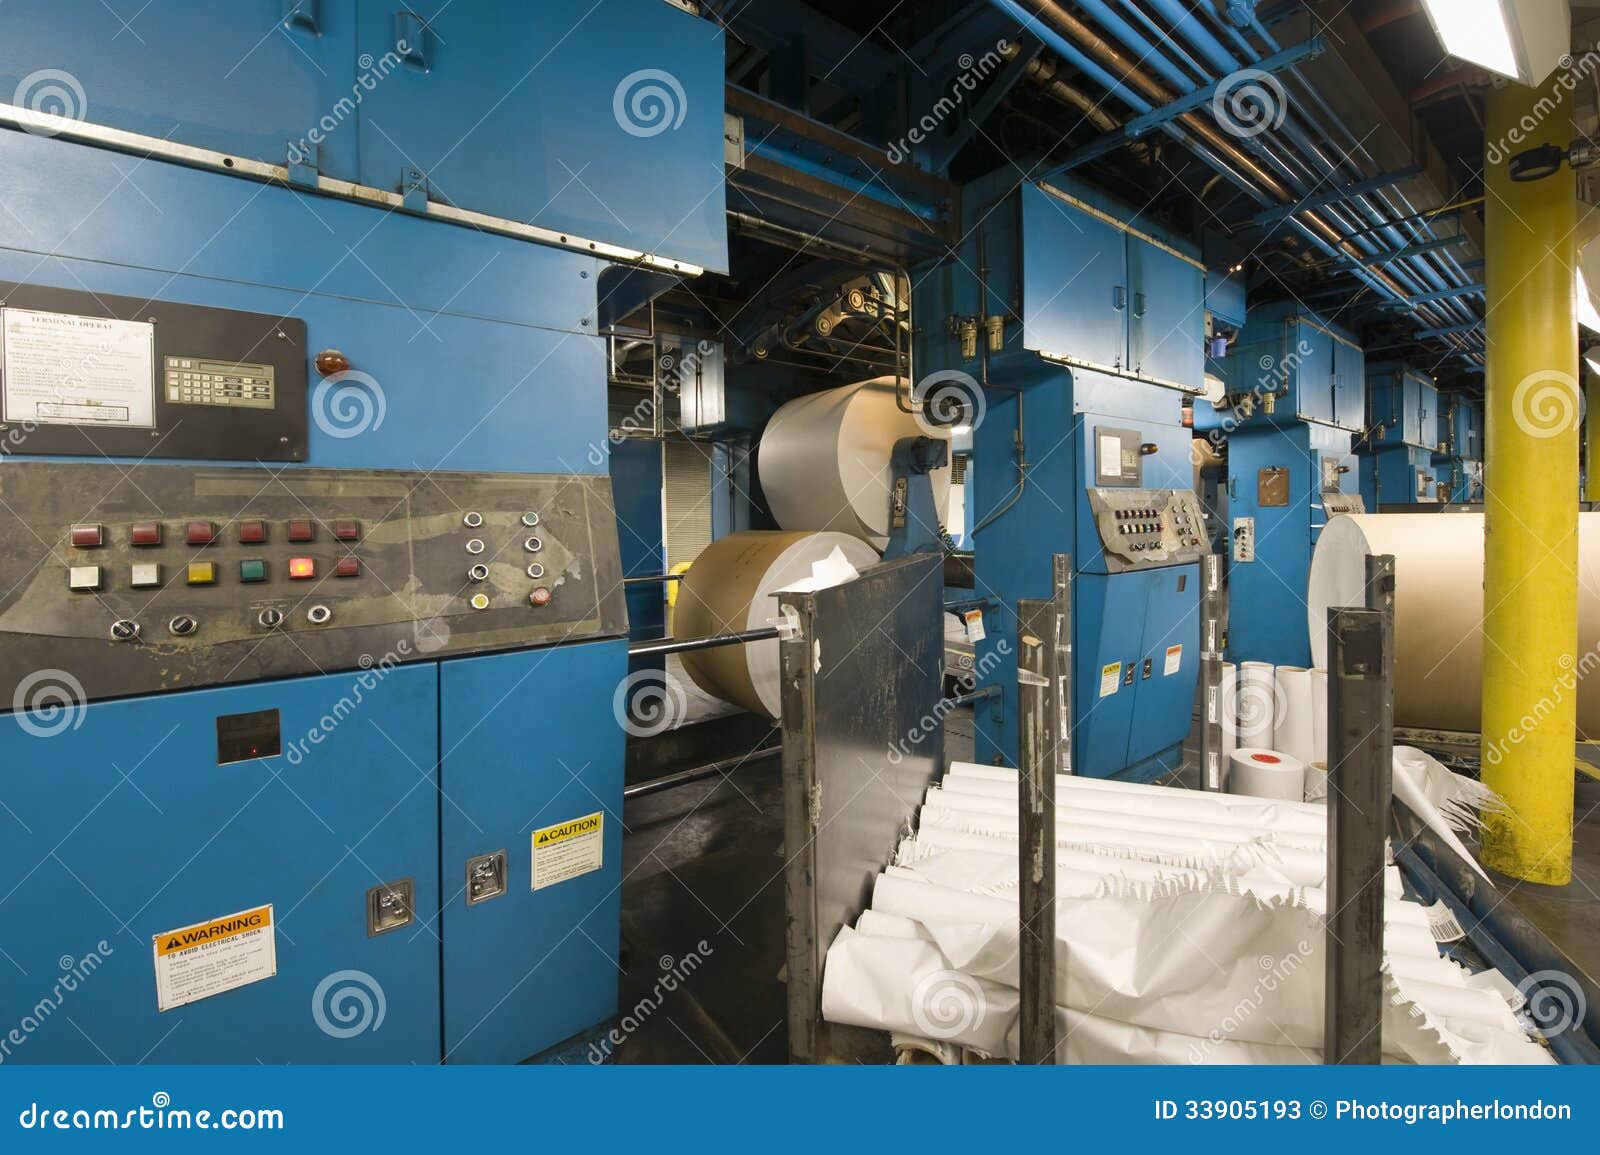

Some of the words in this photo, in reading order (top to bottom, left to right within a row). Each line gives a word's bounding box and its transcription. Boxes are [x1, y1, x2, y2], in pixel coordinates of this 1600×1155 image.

[31, 315, 77, 328] TERMINAL
[549, 818, 598, 840] CAUTION
[183, 915, 261, 944] WARNING
[179, 946, 199, 957] AVOID
[201, 935, 239, 949] ELECTRICAL
